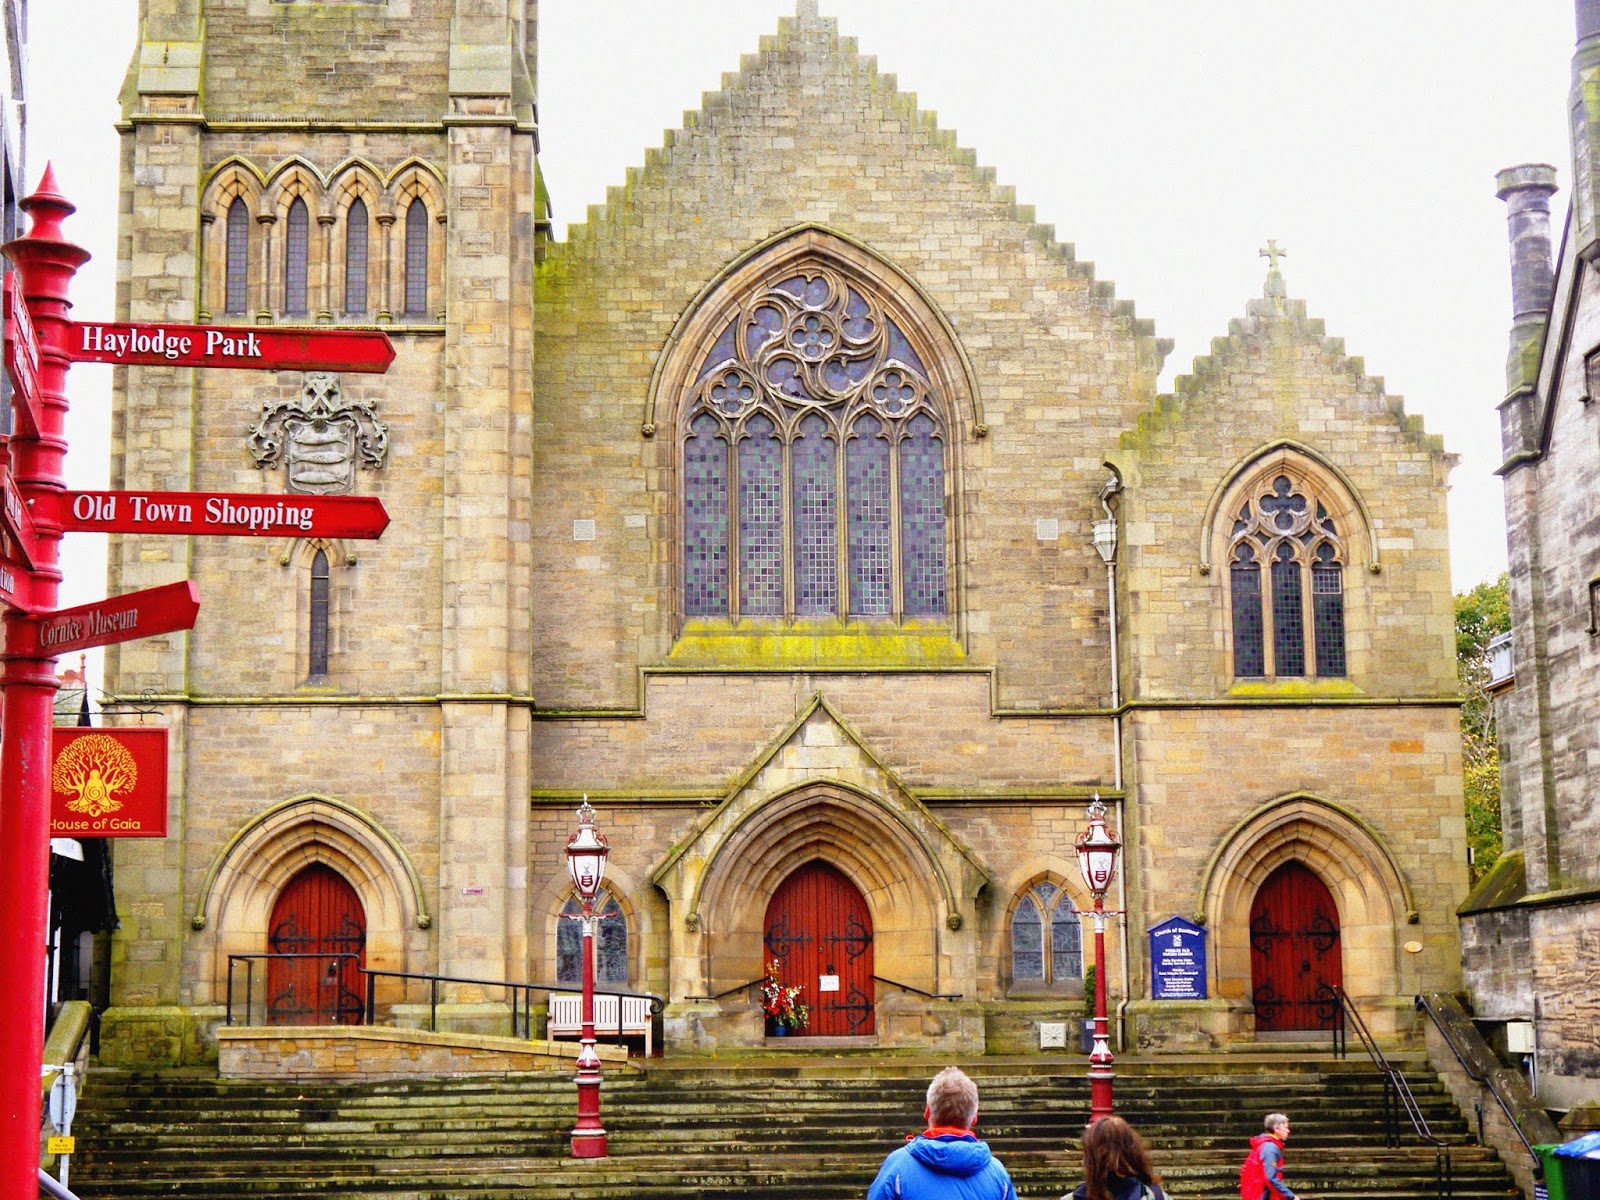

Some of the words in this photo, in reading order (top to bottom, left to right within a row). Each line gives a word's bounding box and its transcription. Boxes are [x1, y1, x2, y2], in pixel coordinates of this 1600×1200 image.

[81, 325, 192, 359] Haylodge
[205, 330, 262, 357] Park
[72, 494, 116, 521] Old
[129, 496, 192, 523] Town
[205, 497, 314, 530] Shopping
[40, 618, 82, 647] Cornice
[88, 608, 138, 636] Museum
[50, 818, 89, 830] House
[92, 818, 107, 830] of
[109, 818, 141, 830] Gaia
[1154, 928, 1171, 938] Church
